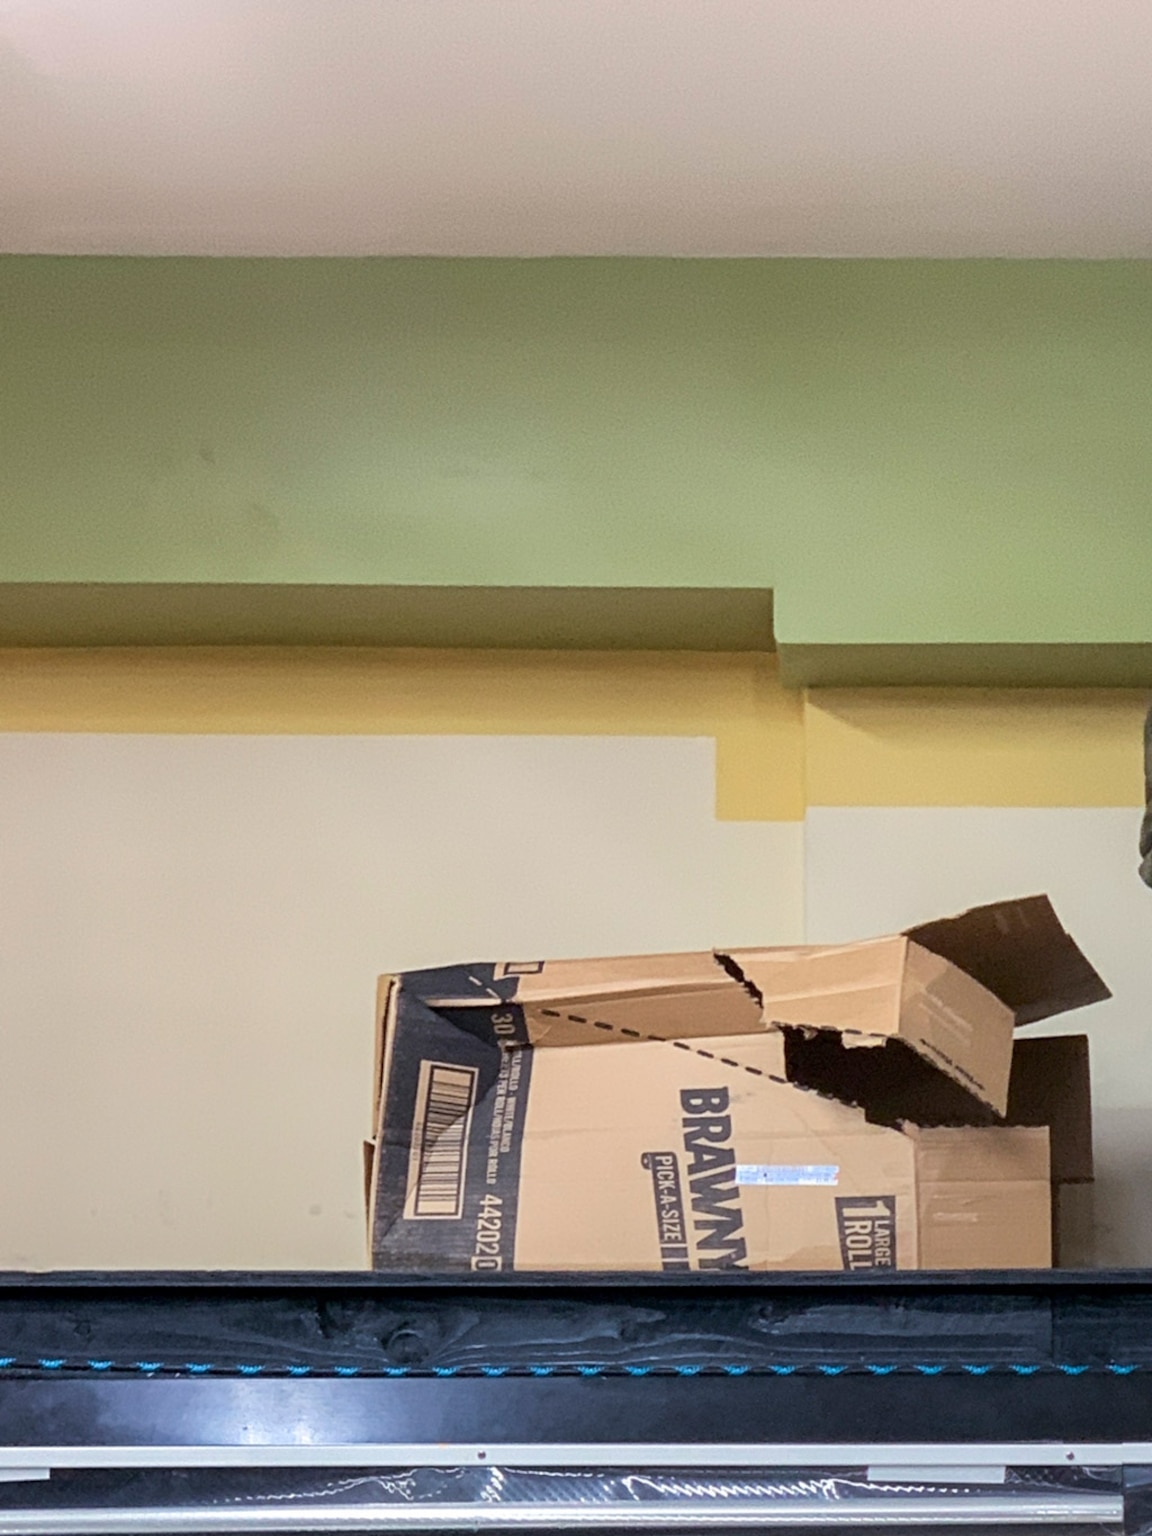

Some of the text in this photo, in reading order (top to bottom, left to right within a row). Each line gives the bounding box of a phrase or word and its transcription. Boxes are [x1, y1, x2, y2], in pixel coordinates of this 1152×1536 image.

[655, 1155, 682, 1242] PICK-A-SIZE
[680, 1086, 749, 1271] BRAWNY
[874, 1220, 891, 1267] LARGE
